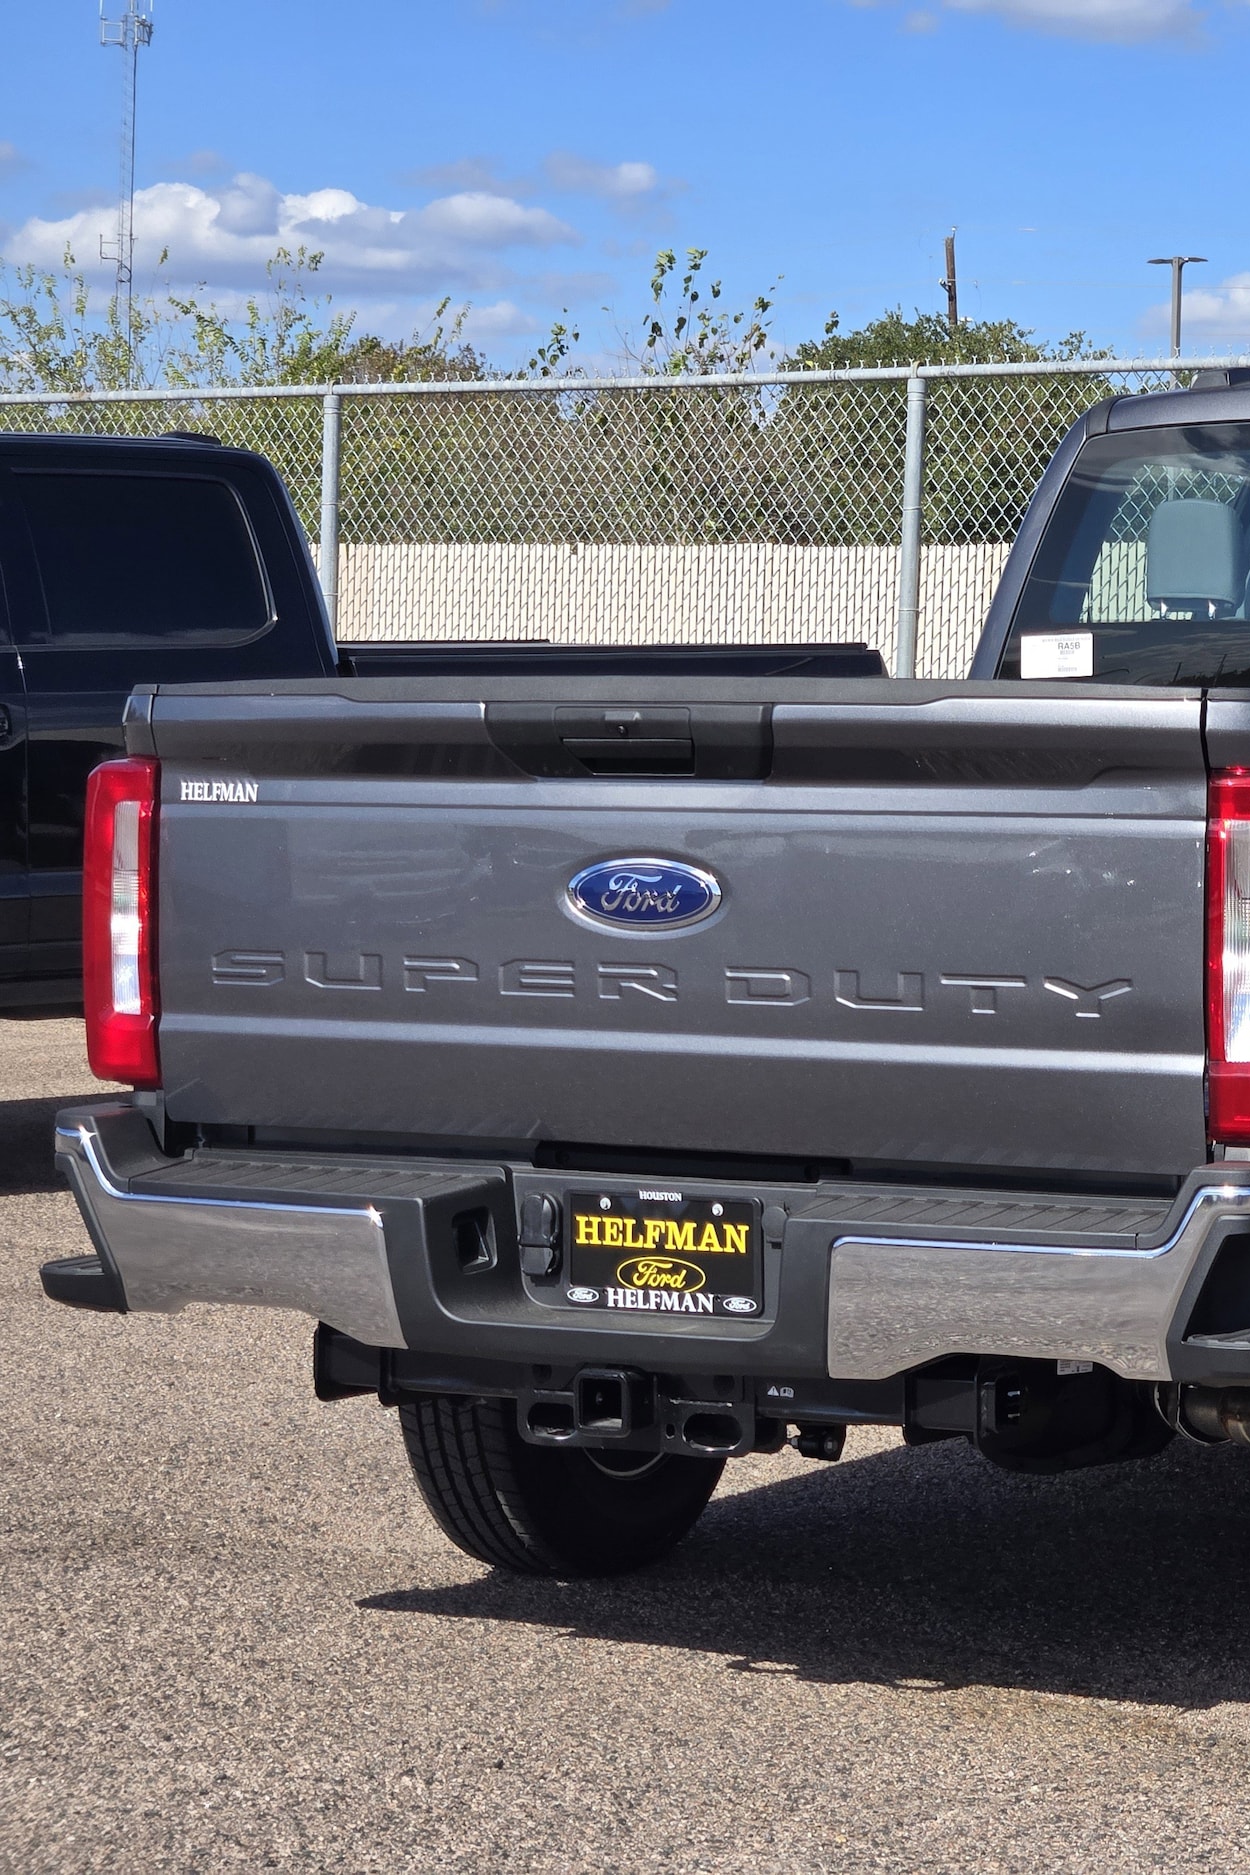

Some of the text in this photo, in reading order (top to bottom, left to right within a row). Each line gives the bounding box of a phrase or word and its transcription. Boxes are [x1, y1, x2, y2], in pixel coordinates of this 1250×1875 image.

[180, 780, 259, 802] HELFMAN
[600, 872, 682, 913] Ford
[212, 949, 1132, 1018] SUPER DUTY
[638, 1190, 682, 1202] HOUSTON
[575, 1214, 750, 1254] HELFMAN
[632, 1260, 687, 1289] Ford
[606, 1287, 715, 1314] HELFMAN
